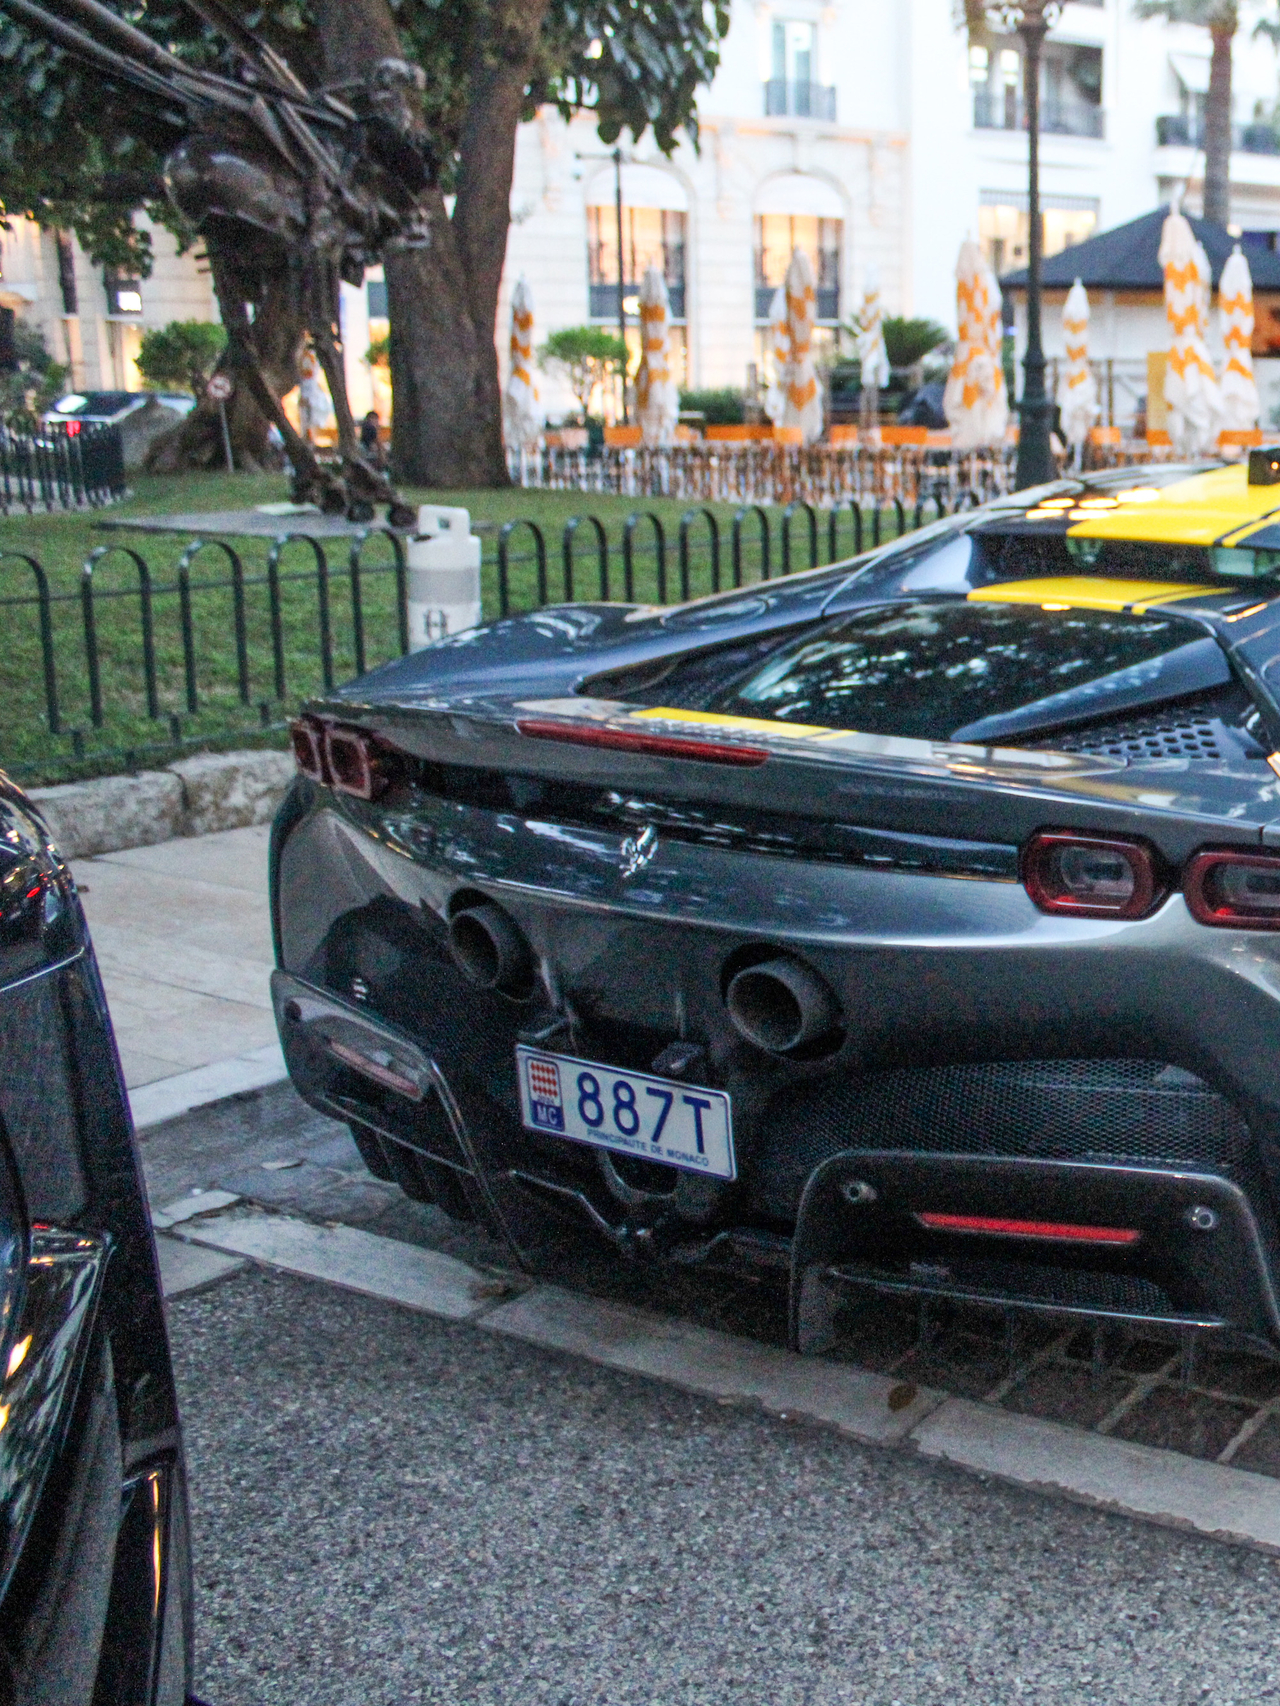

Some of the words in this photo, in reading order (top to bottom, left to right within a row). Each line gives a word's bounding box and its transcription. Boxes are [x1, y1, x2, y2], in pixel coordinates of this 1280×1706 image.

[537, 1104, 558, 1125] MC
[577, 1072, 711, 1154] 887T
[650, 1144, 664, 1156] DE
[667, 1149, 709, 1167] MONACO
